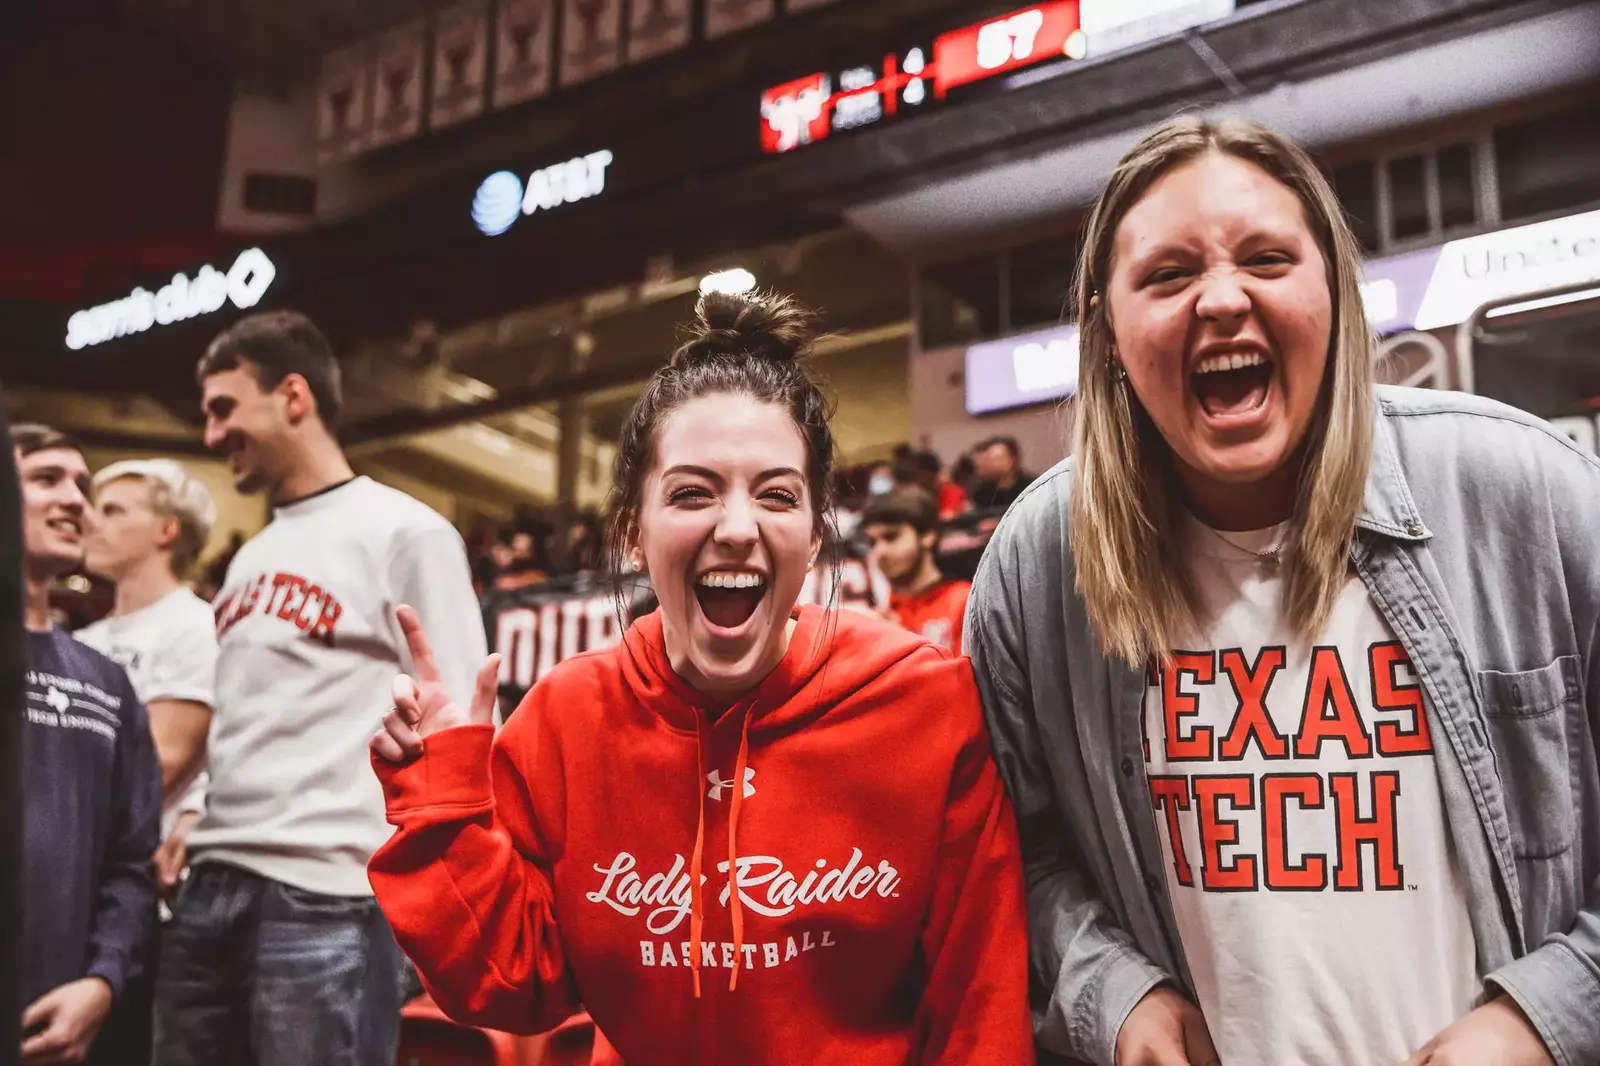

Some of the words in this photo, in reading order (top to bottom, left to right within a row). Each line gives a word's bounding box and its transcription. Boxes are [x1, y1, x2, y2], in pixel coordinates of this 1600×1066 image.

[264, 571, 343, 648] TECH
[1148, 770, 1405, 893] TECH
[585, 851, 708, 936] Lady
[716, 847, 901, 918] Raider
[639, 930, 837, 970] BASKETBALL
